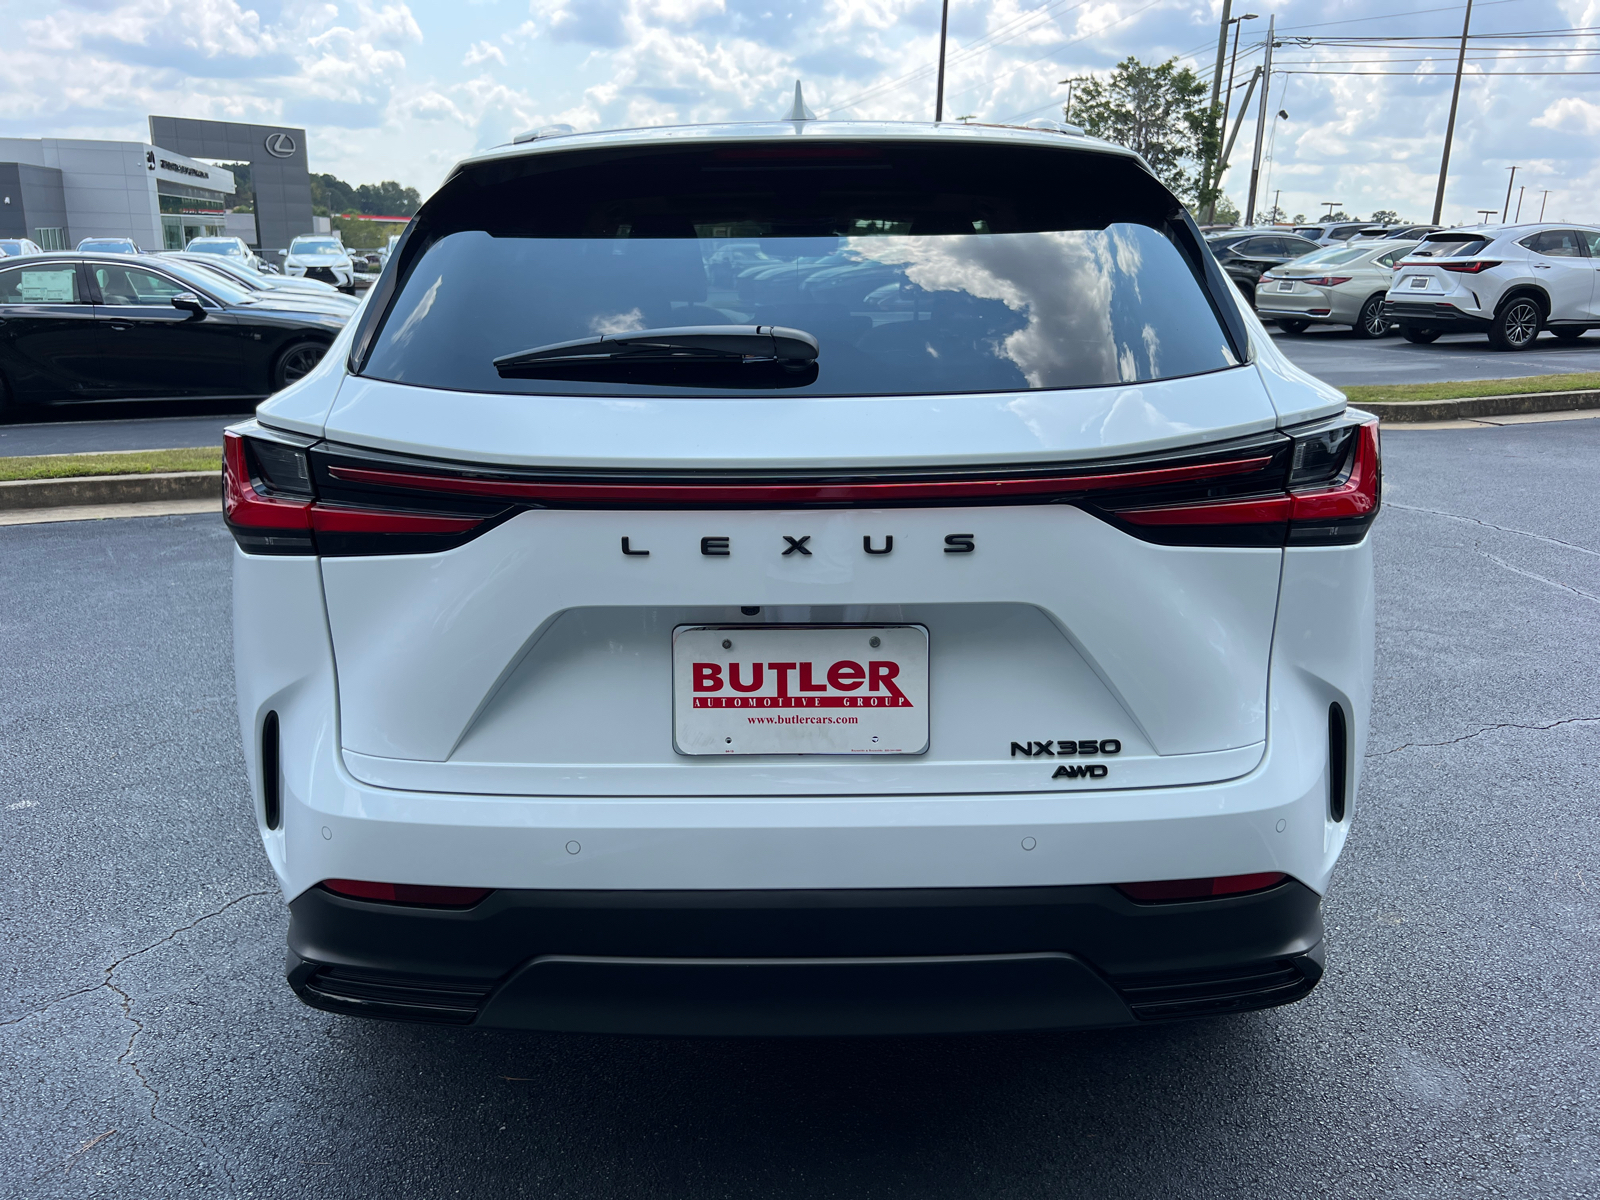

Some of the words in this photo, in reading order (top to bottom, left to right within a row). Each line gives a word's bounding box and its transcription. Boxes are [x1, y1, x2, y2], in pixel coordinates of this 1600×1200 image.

[621, 533, 975, 556] LEXUS
[694, 698, 822, 707] AUTOMOTIVE
[843, 697, 906, 707] GROUP
[747, 715, 859, 725] www.butlercars.com
[1010, 738, 1122, 756] NX350
[1051, 764, 1108, 778] AWD
